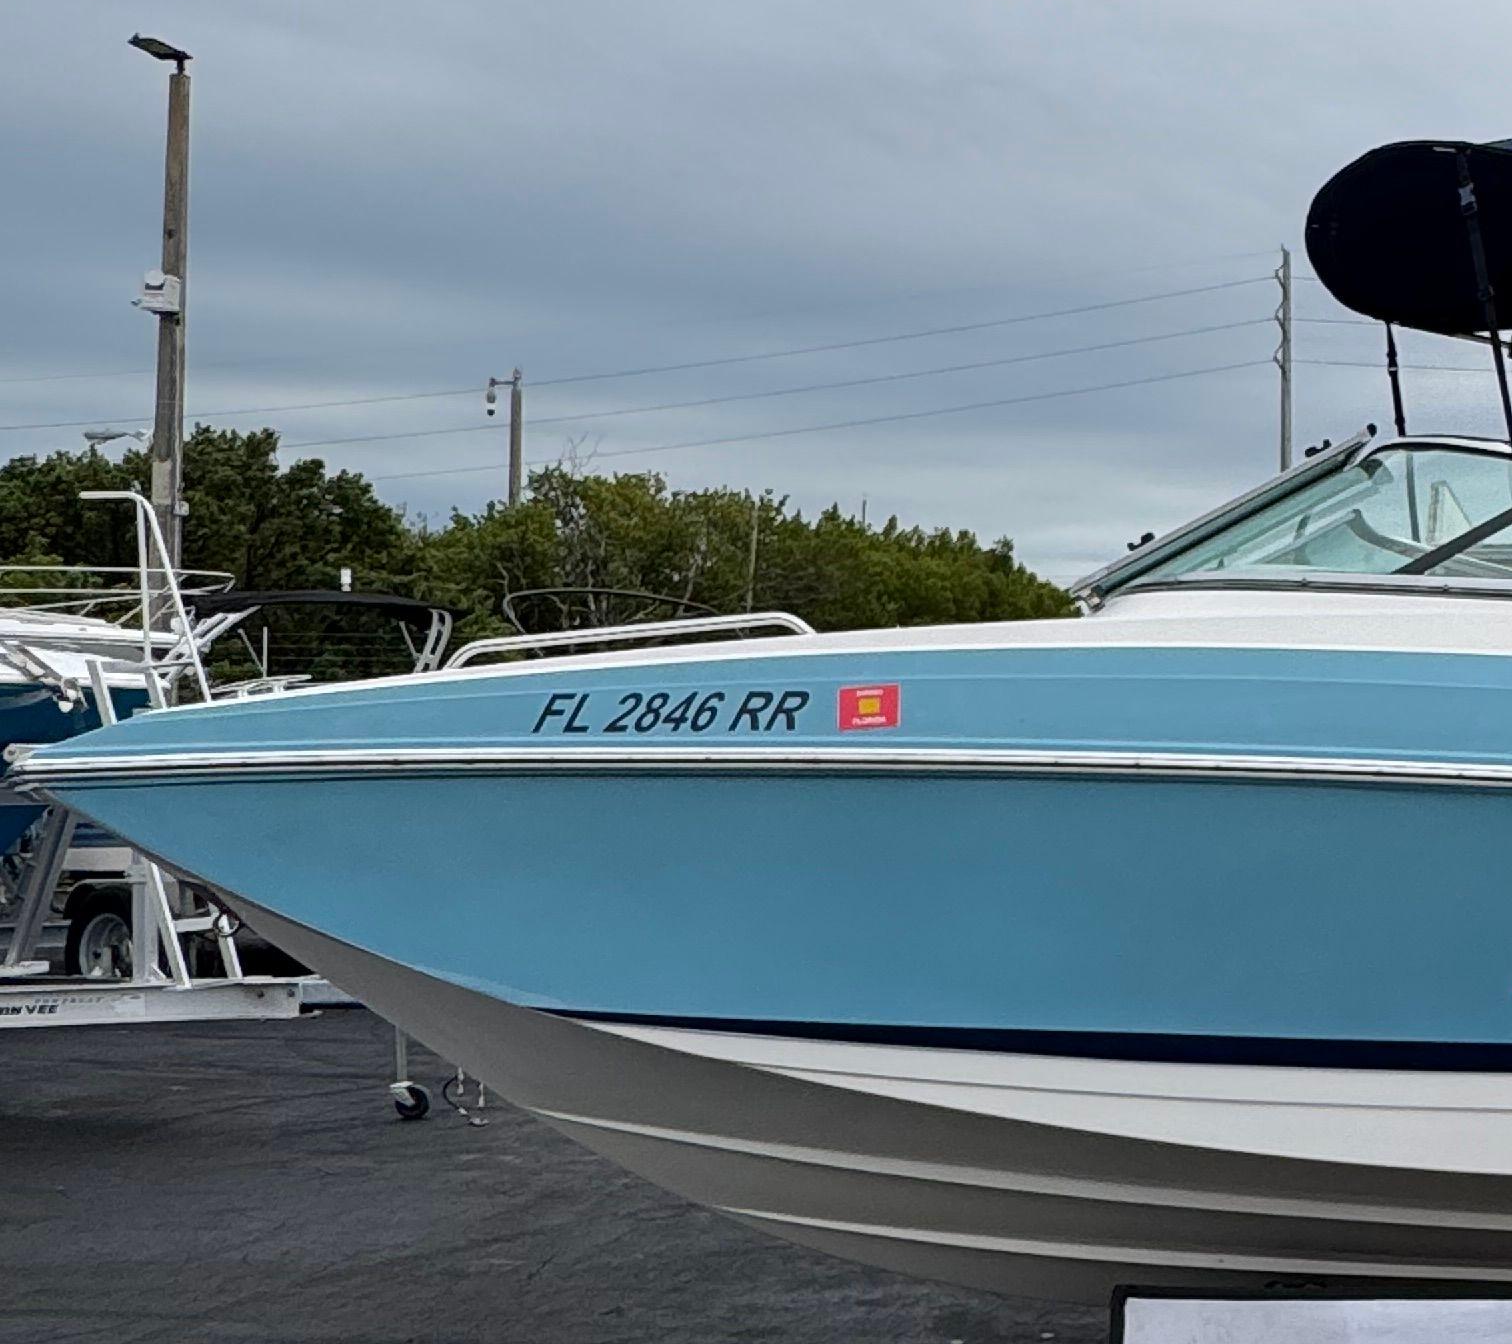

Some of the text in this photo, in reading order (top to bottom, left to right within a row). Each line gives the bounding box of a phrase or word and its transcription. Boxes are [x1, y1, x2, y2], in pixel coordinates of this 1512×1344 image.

[531, 690, 810, 734] FL 2846 RR
